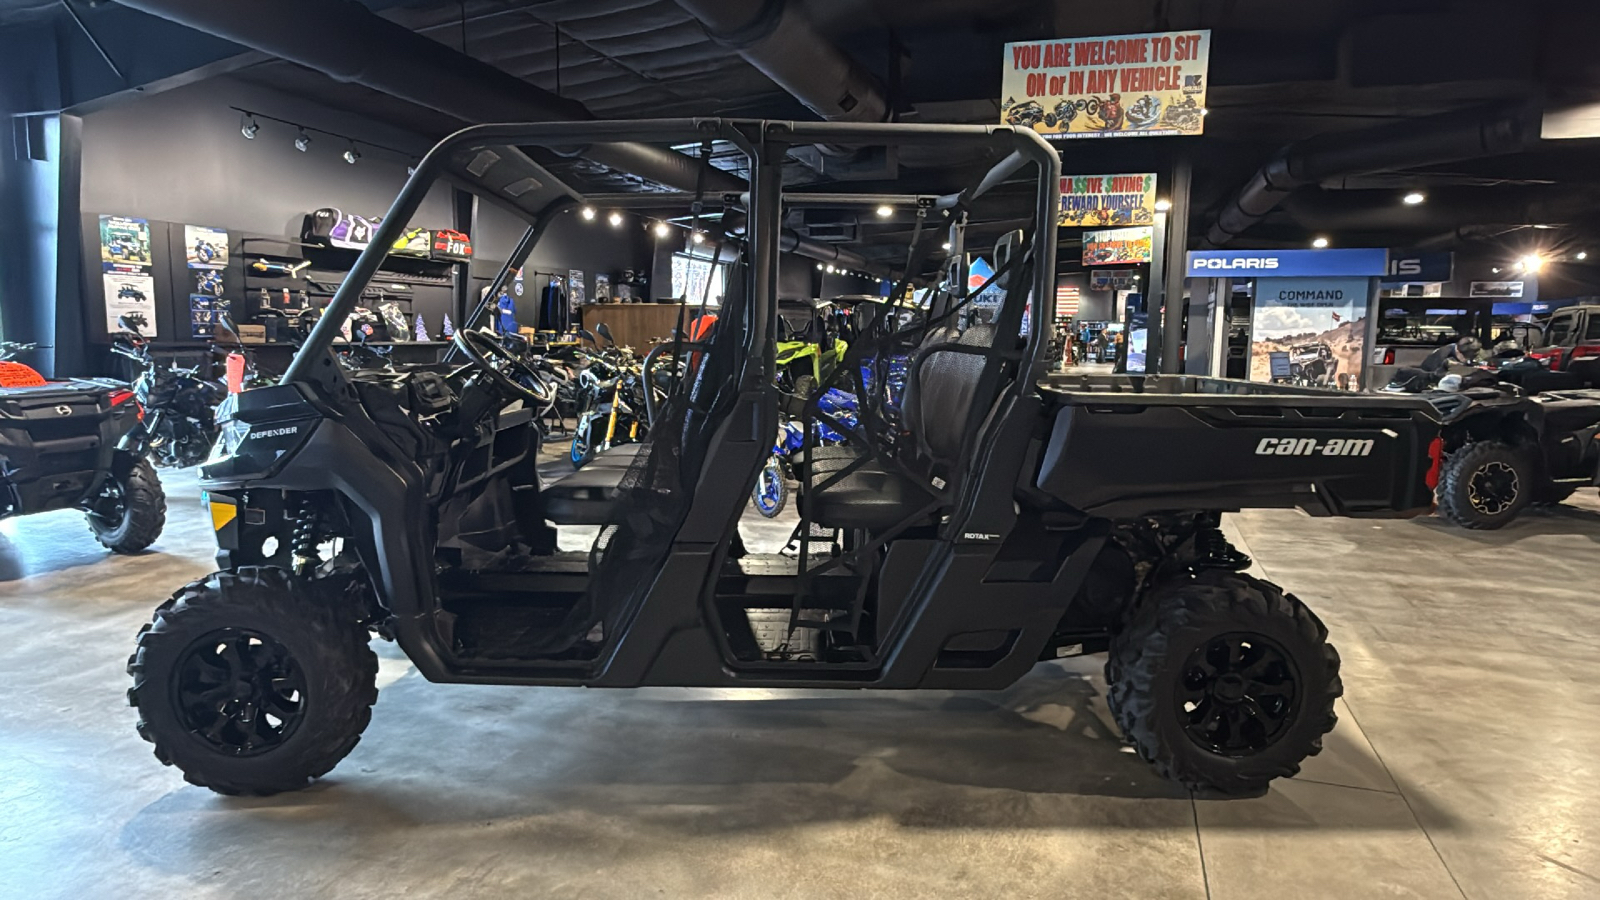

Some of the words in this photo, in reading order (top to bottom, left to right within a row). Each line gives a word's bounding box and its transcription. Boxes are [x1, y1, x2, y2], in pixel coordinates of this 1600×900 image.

[1013, 45, 1041, 70] YOU
[1043, 43, 1072, 68] ARE
[1074, 38, 1148, 67] WELCOME
[1151, 36, 1171, 62] TO
[1174, 35, 1201, 61] SIT
[1026, 73, 1047, 97] ON
[1050, 76, 1066, 96] or
[1068, 71, 1084, 95] IN
[1086, 69, 1118, 94] ANY
[1120, 66, 1182, 92] VEHICLE
[1062, 194, 1099, 211] REWARD
[1101, 194, 1144, 210] YOURSELF
[447, 242, 465, 255] FOX
[1193, 257, 1279, 269] POLARIS
[1391, 259, 1421, 275] IS
[974, 294, 999, 303] UKI
[1279, 289, 1344, 301] COMMAND
[250, 426, 298, 439] DEFENDER
[1254, 437, 1375, 456] can-am
[964, 532, 990, 540] ROTAX
